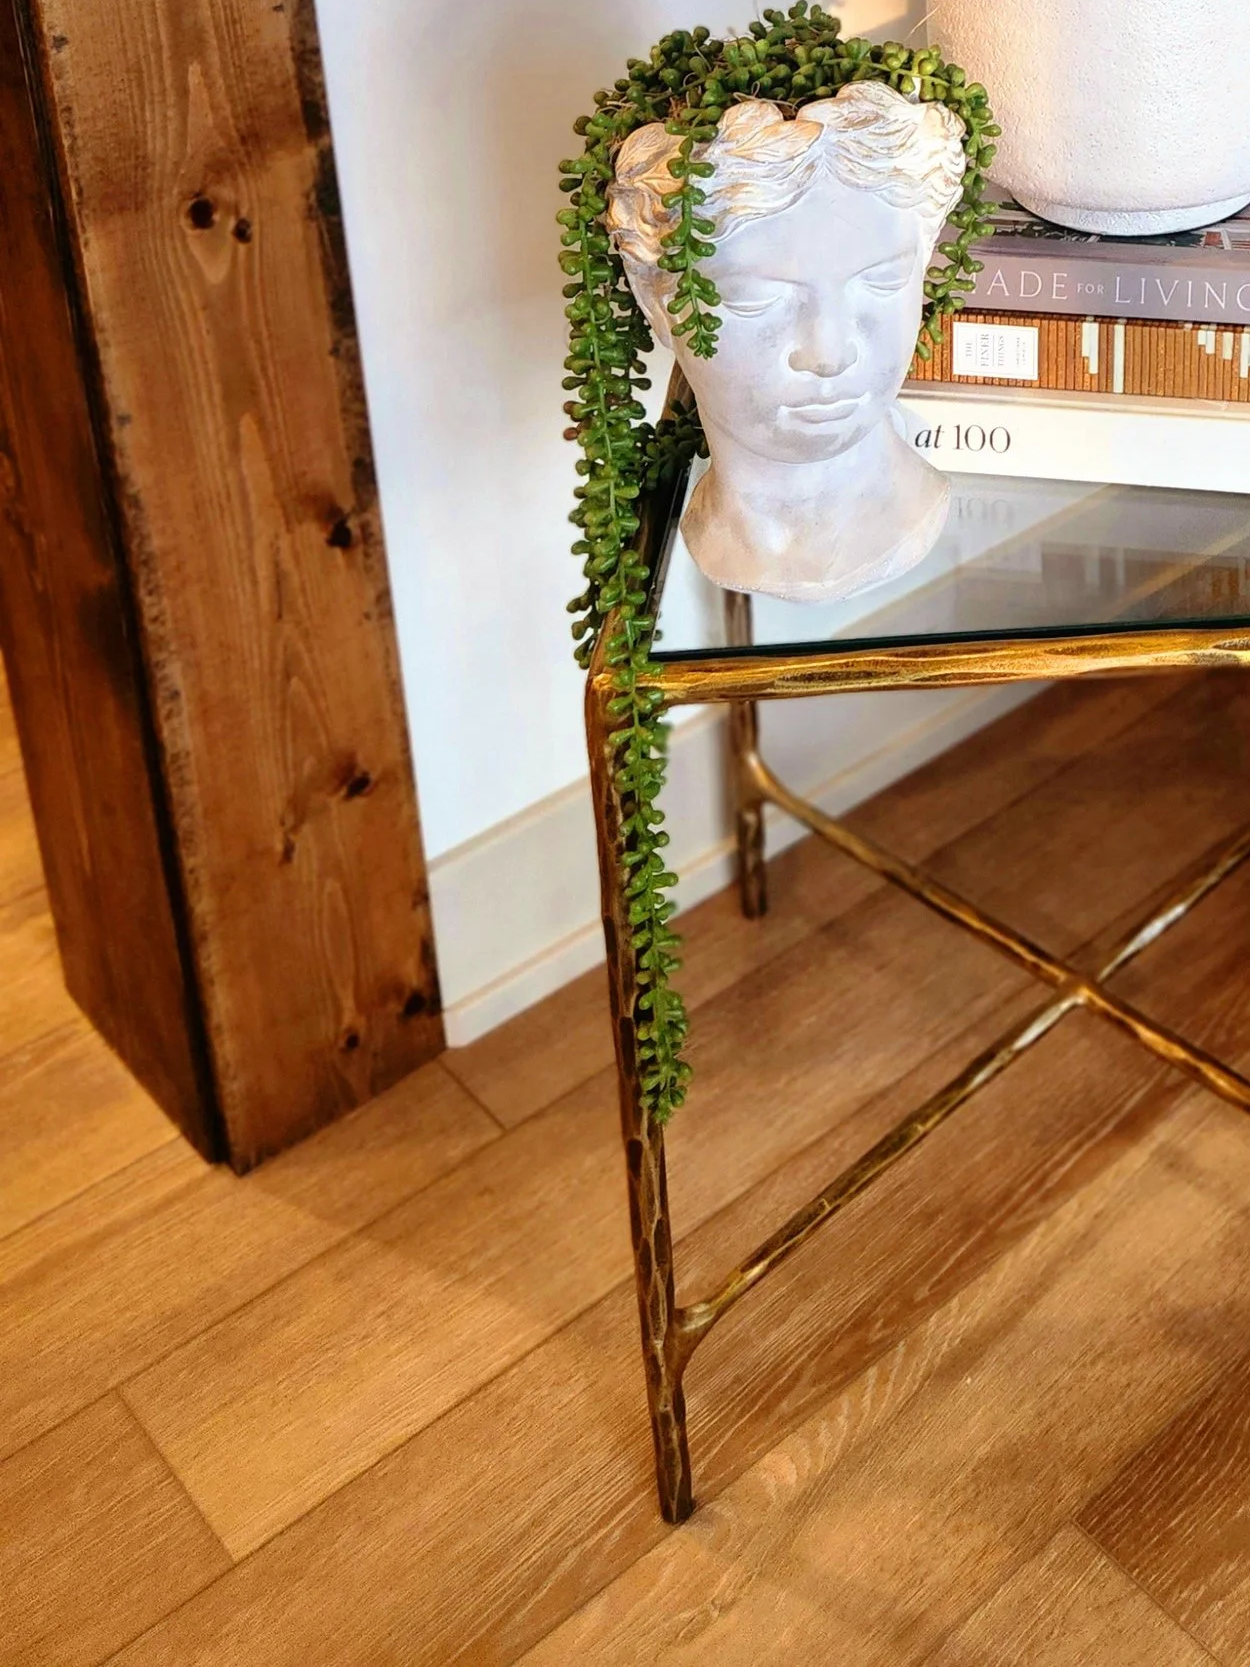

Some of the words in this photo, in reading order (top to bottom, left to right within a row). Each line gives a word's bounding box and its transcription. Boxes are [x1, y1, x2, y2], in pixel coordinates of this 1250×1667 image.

[1076, 282, 1105, 295] FOR
[980, 333, 990, 367] FINER
[914, 424, 945, 449] at
[951, 423, 1012, 454] 100
